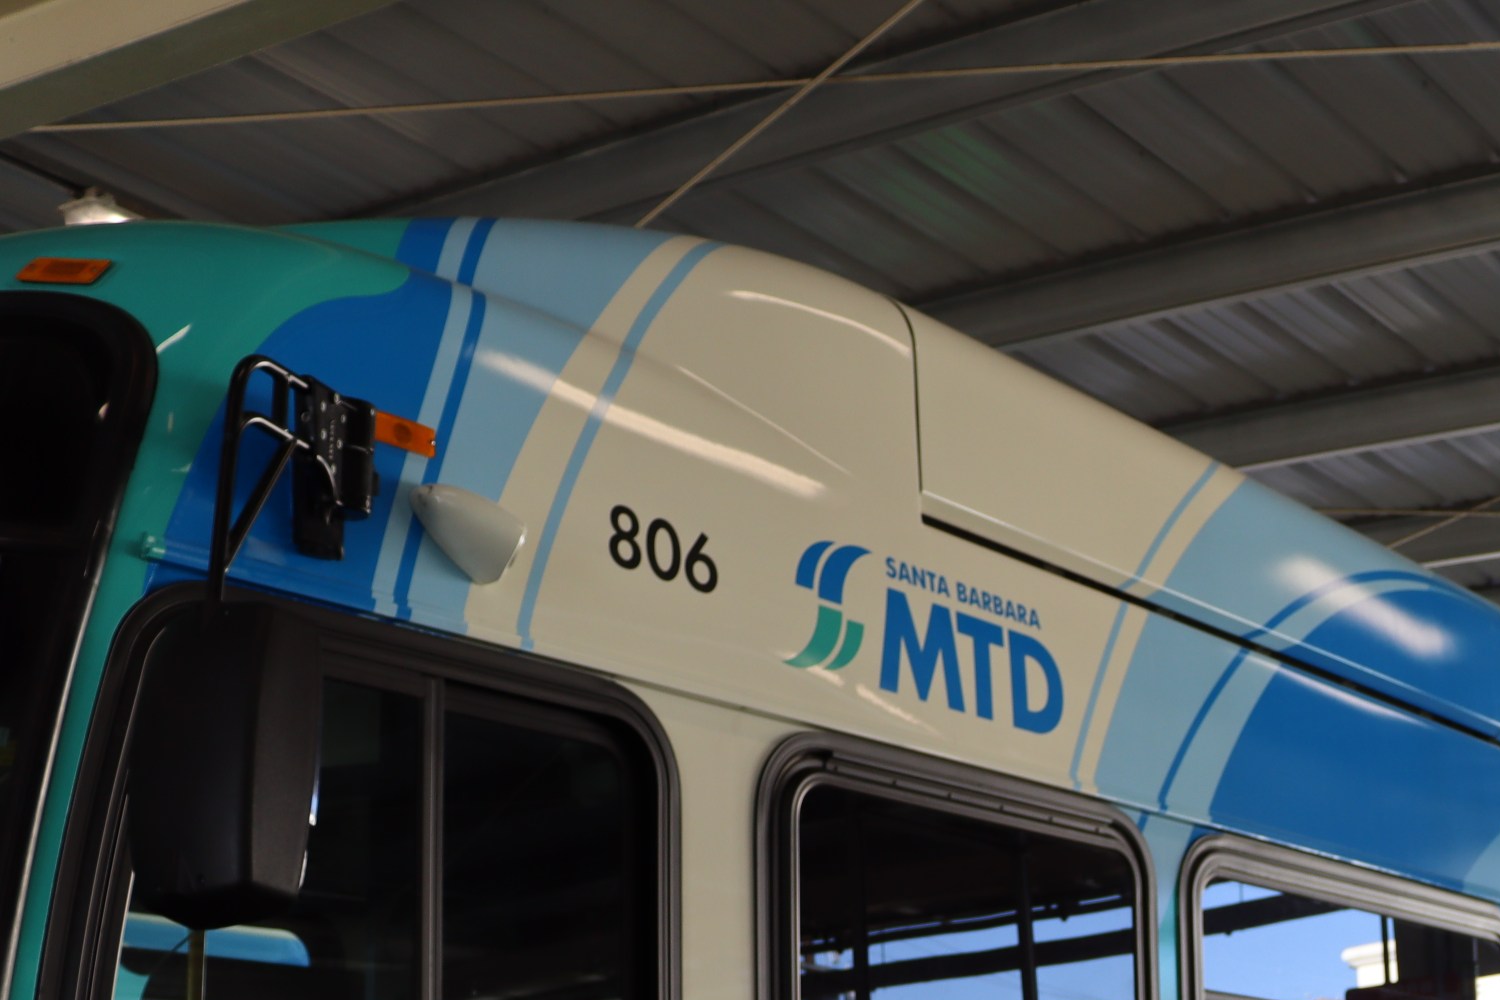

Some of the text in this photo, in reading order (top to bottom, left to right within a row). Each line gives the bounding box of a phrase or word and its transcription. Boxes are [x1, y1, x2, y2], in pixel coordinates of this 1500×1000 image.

[607, 504, 719, 594] 806
[885, 556, 1041, 630] SANTA BARBARA
[878, 588, 1064, 735] MTD
